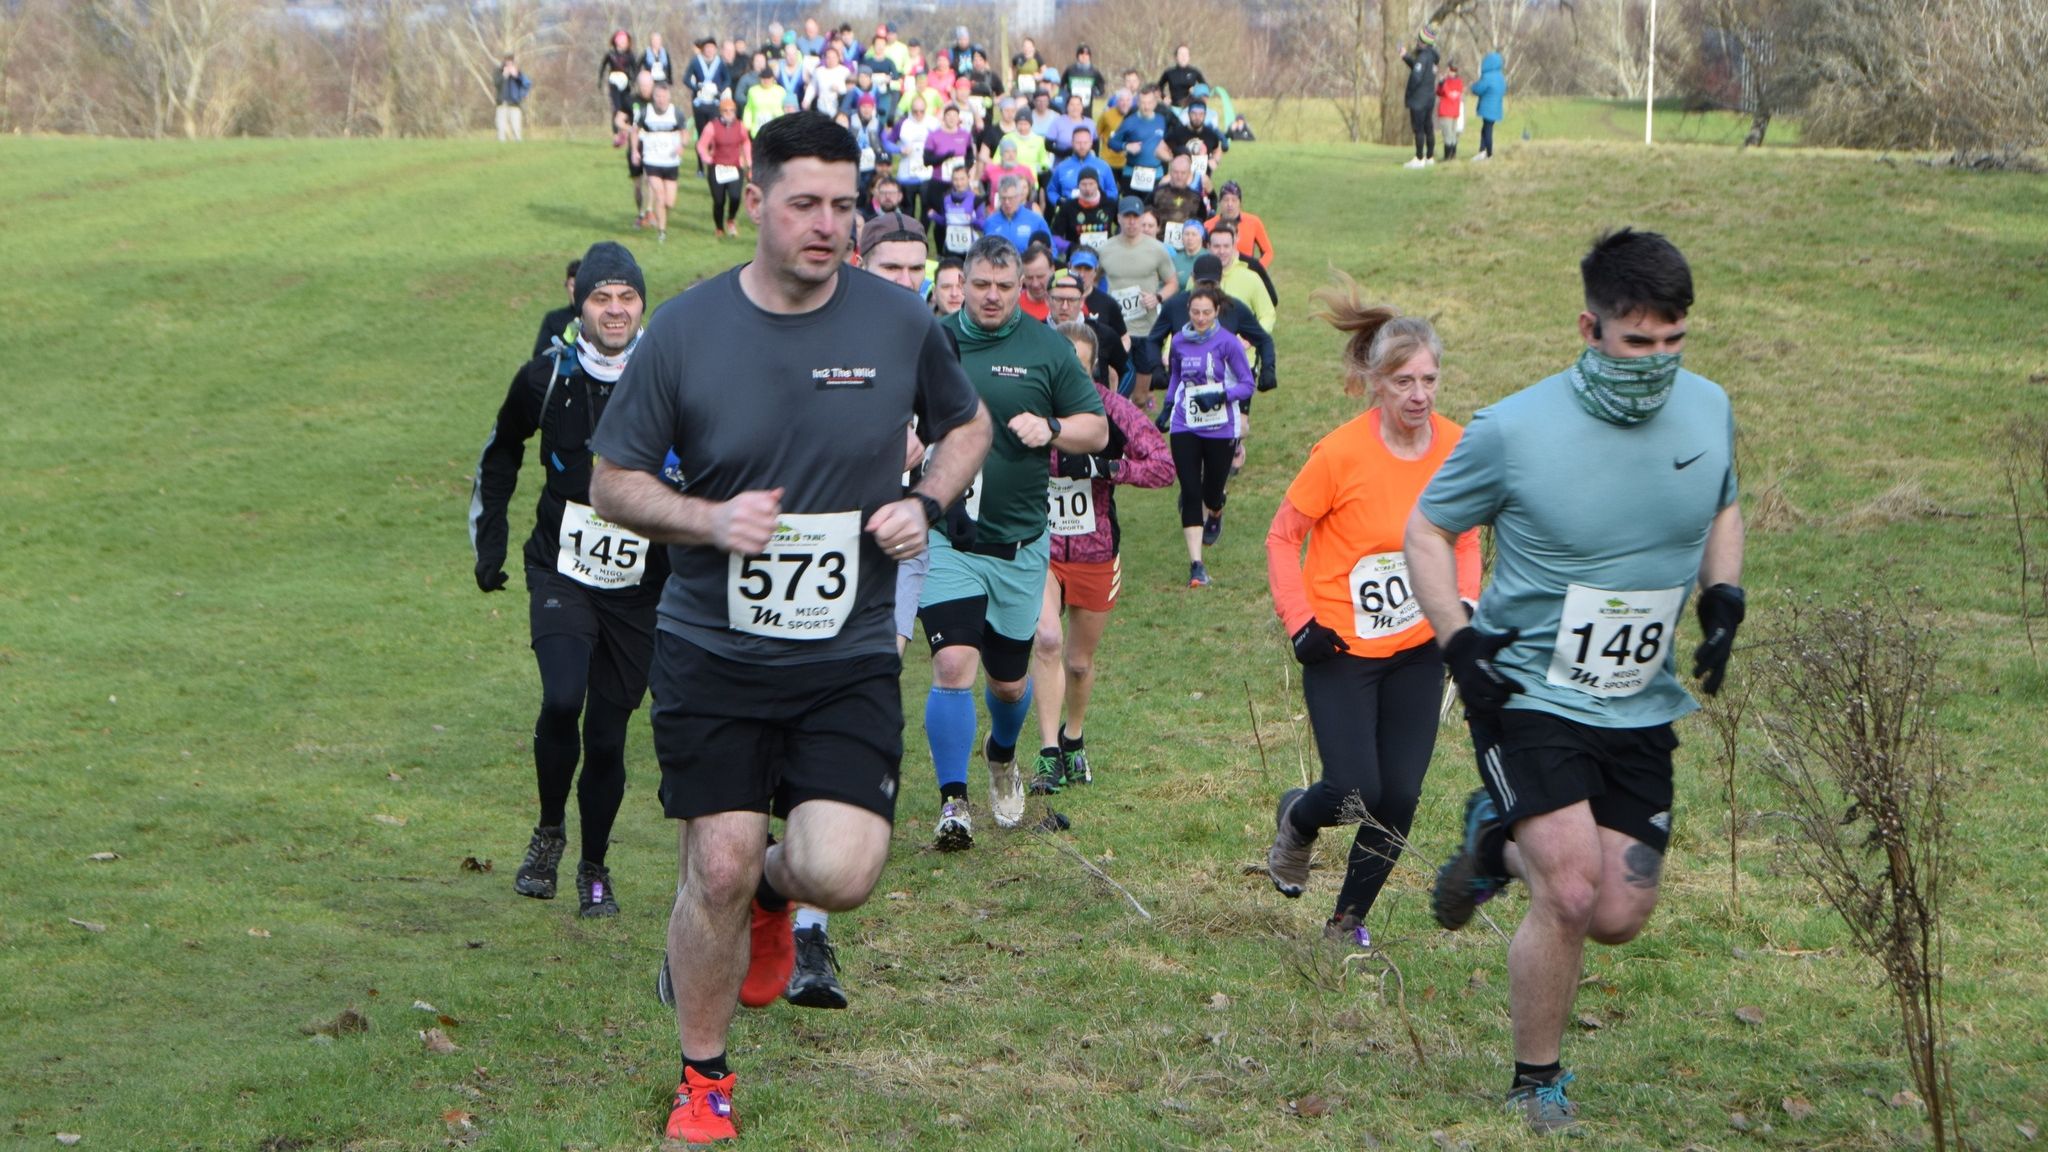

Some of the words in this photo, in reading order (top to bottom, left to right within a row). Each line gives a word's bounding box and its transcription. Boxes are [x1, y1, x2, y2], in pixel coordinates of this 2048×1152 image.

[831, 368, 852, 377] The
[852, 368, 877, 377] Wild
[568, 529, 639, 569] 145
[600, 568, 623, 577] MIGO
[738, 551, 847, 602] 573
[1359, 575, 1408, 612] 60
[795, 606, 830, 617] MIGO
[787, 618, 836, 630] SPORTS
[1572, 621, 1663, 666] 148
